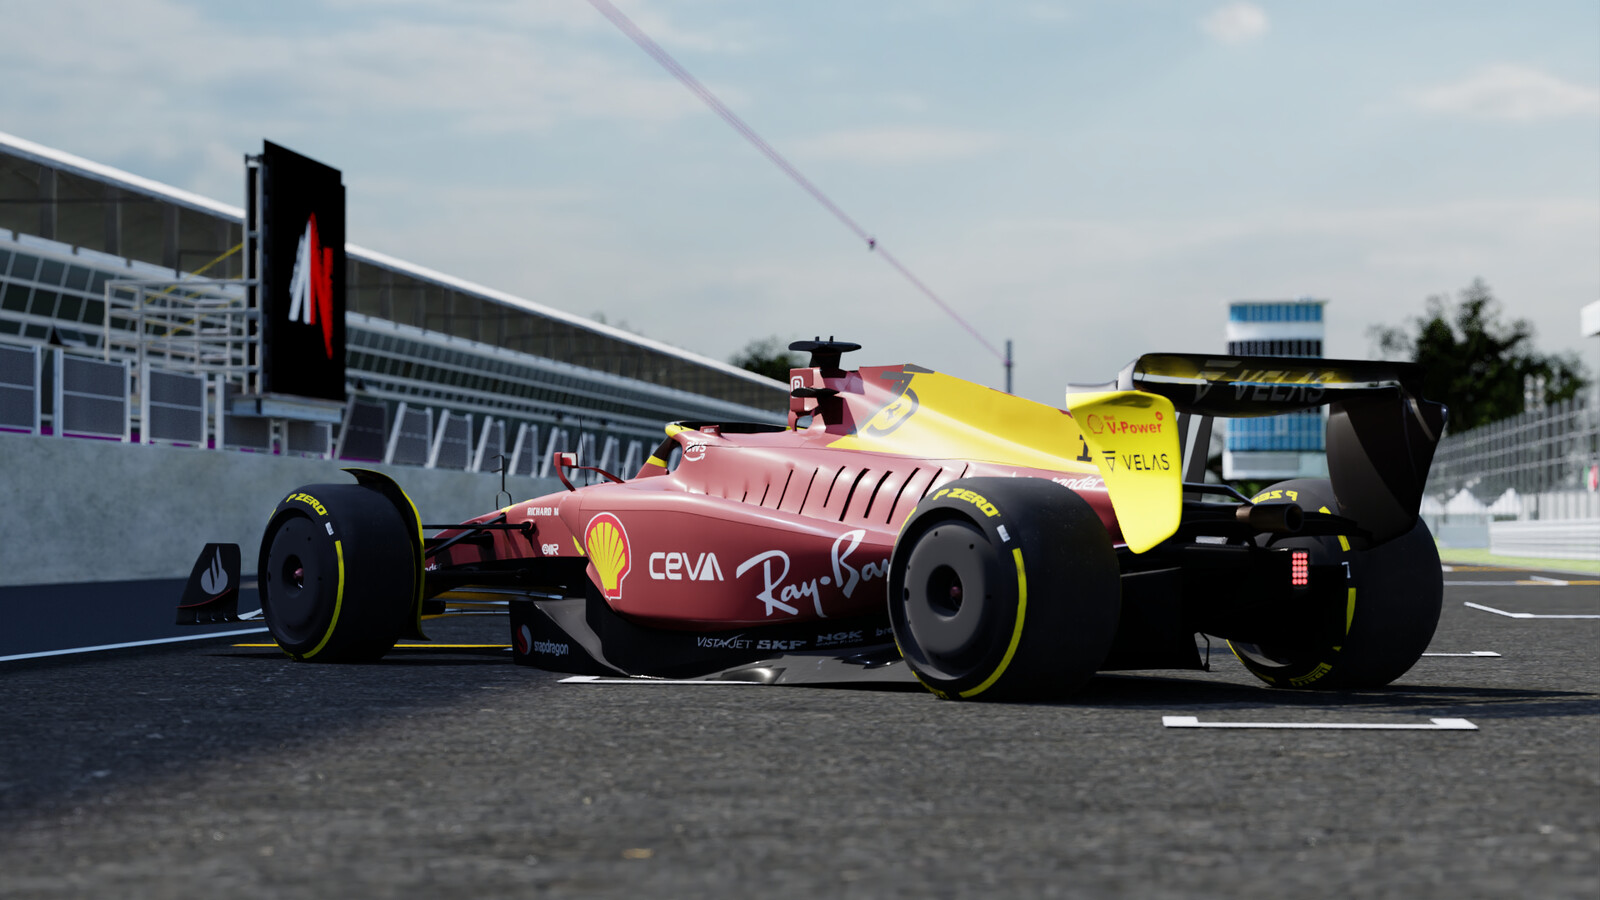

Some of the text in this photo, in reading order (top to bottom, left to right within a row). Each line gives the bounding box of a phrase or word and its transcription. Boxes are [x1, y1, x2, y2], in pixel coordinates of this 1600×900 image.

[1122, 453, 1170, 470] VELAS
[295, 492, 327, 516] ZERO
[932, 487, 999, 517] P ZERO
[527, 507, 552, 516] RICHARD
[534, 638, 569, 657] snapdragon
[756, 639, 807, 650] SKF
